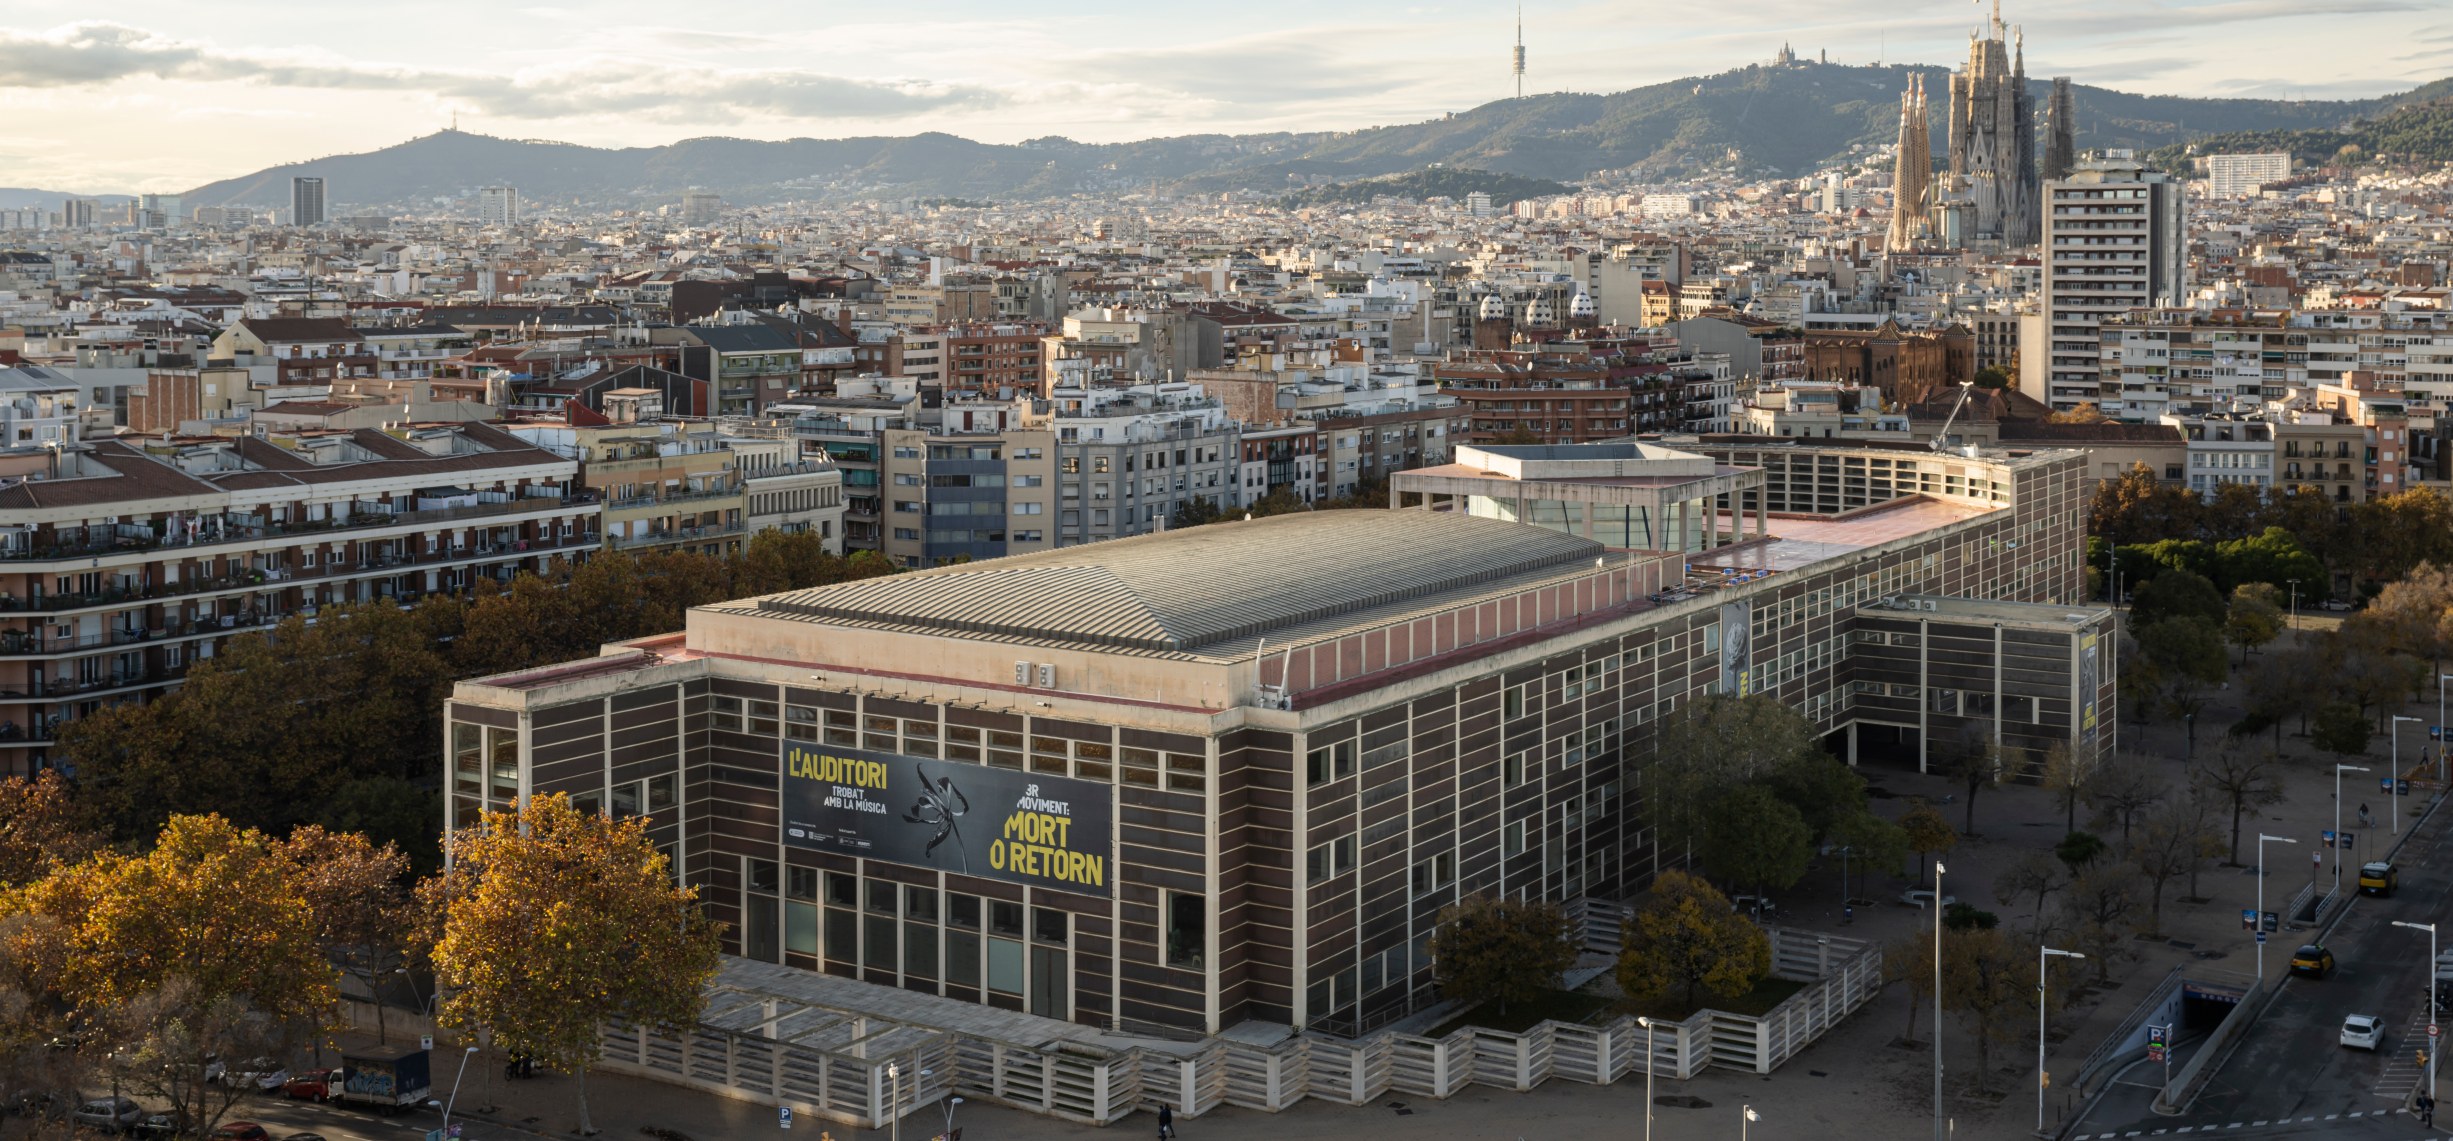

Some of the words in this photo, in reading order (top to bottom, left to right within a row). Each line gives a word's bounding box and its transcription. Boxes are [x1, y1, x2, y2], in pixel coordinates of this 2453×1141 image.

[789, 747, 887, 789] L'AUDITORI
[832, 786, 864, 799] TROBA'T
[1025, 784, 1039, 797] 3R
[824, 796, 842, 808] AMB
[844, 799, 854, 810] LA
[855, 799, 887, 814] MÚSICA
[1016, 796, 1070, 815] MOVIMENT:
[1004, 811, 1071, 848] MORT
[990, 839, 1005, 870] O
[1010, 842, 1103, 887] RETORN
[781, 1108, 789, 1119] P
